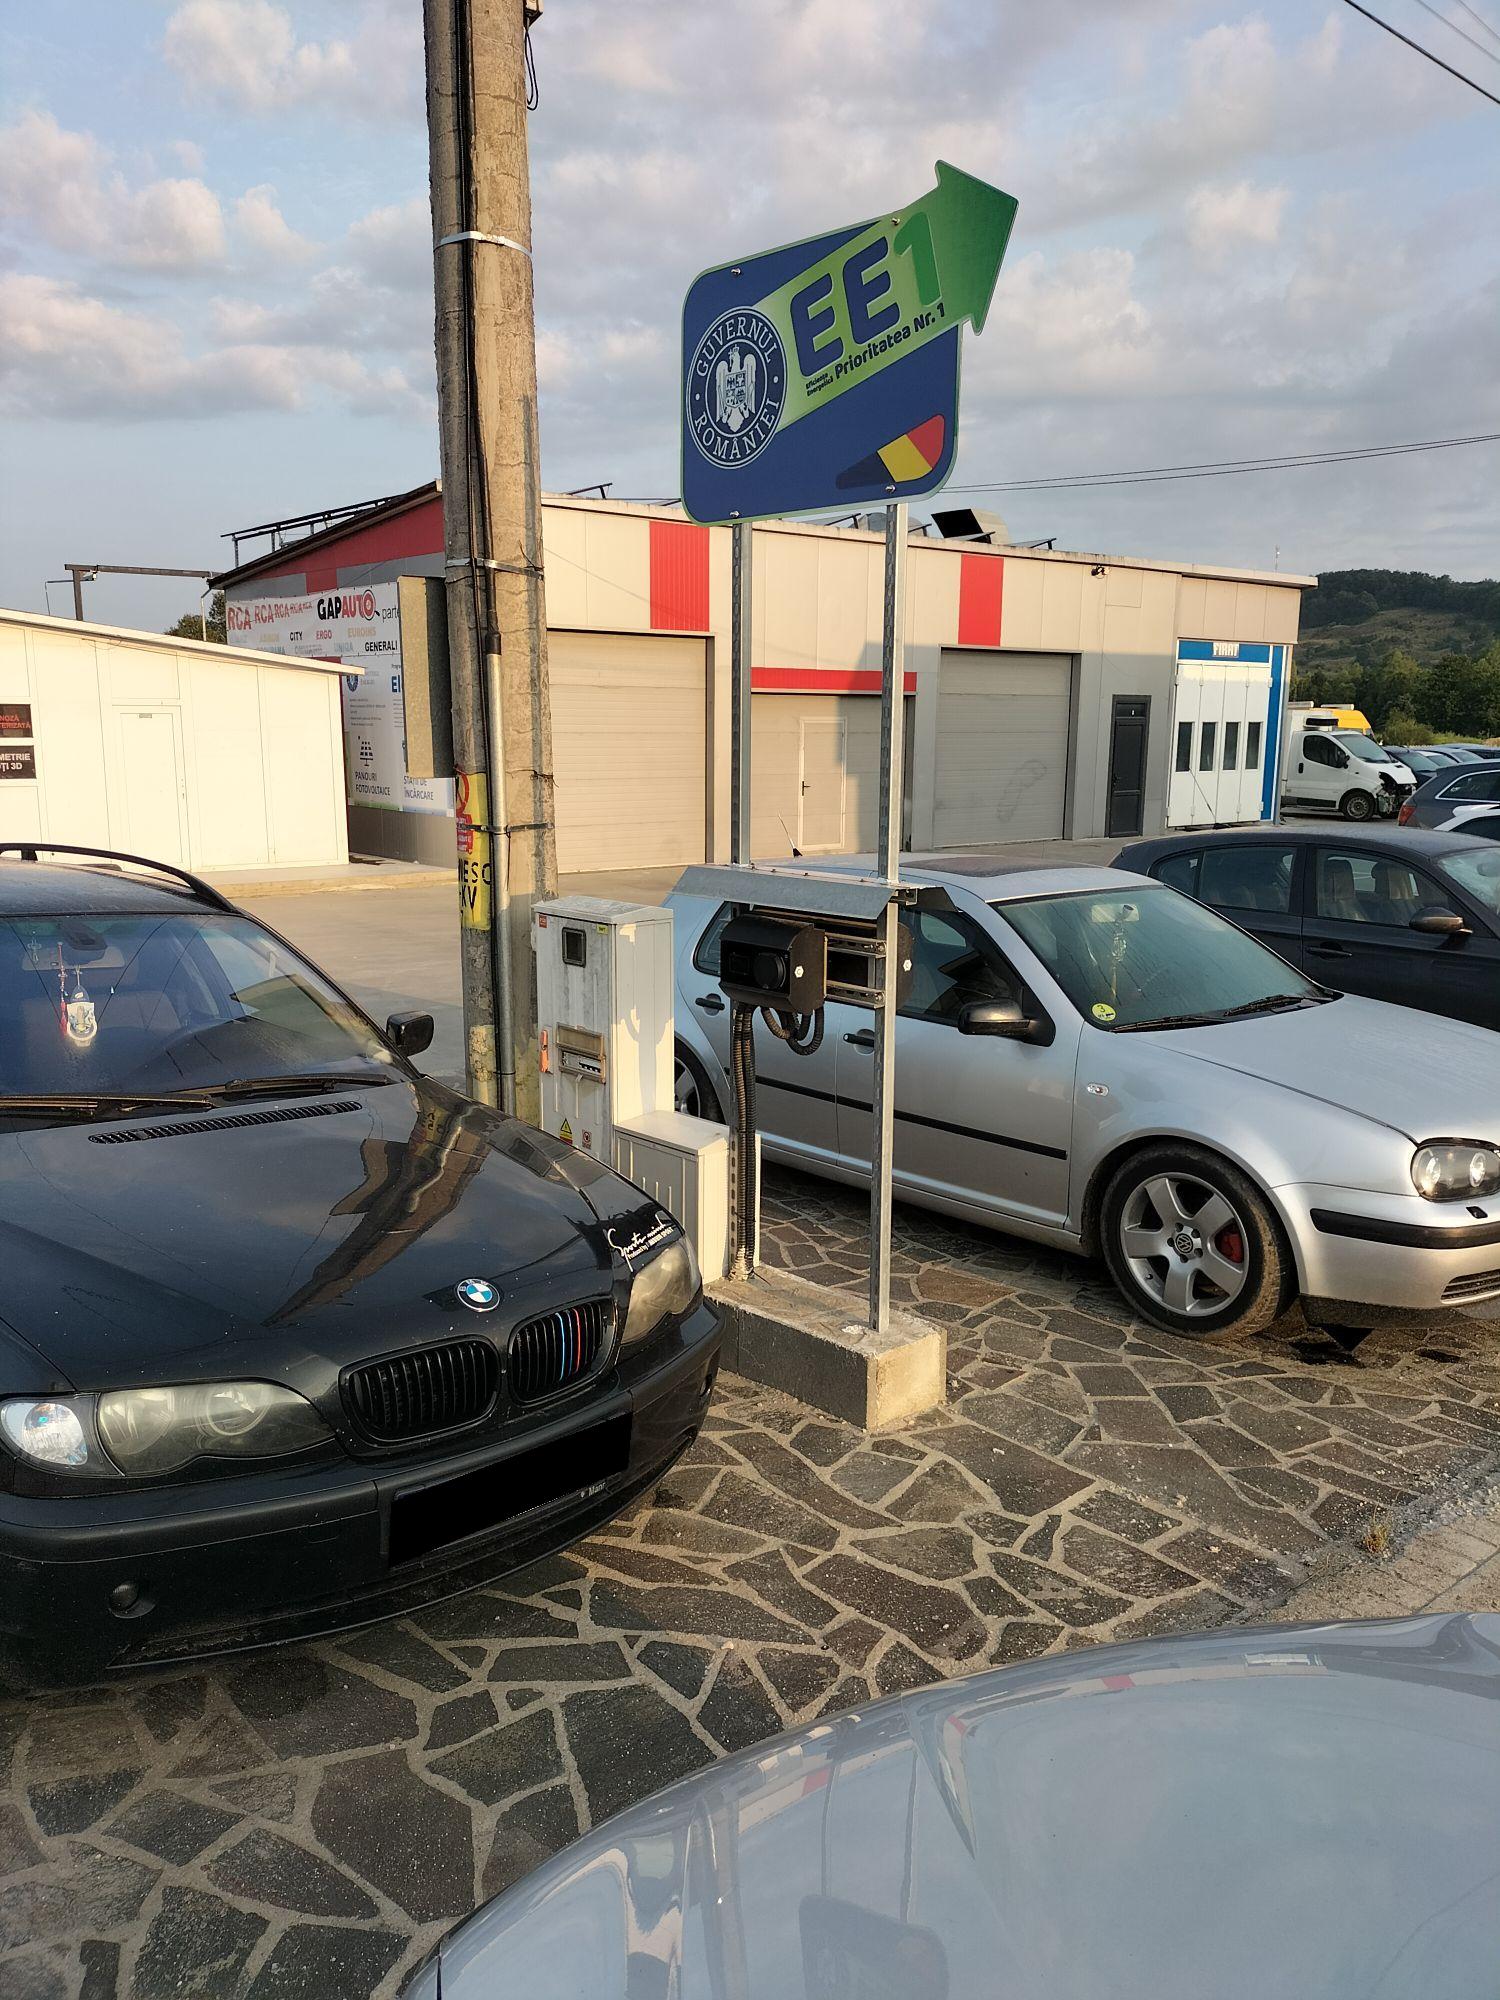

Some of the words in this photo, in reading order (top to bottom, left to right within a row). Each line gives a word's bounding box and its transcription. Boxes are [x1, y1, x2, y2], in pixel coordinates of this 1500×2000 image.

[790, 210, 942, 377] EE1
[696, 316, 778, 377] GUVERNUL
[834, 325, 912, 380] Prioritatea
[913, 311, 936, 333] Nr.
[936, 302, 946, 318] 1
[694, 398, 780, 460] ROMÂNIEI
[227, 607, 252, 630] RCA
[254, 604, 275, 624] RCA
[274, 602, 290, 619] RCA
[317, 589, 376, 621] GAPAUTO
[289, 631, 303, 641] CITY
[316, 630, 332, 640] ERGO
[364, 640, 398, 652] GENERALI
[10, 762, 23, 770] 3D
[355, 771, 377, 781] PANOURI
[355, 784, 391, 796] FOTOVOLTAICE
